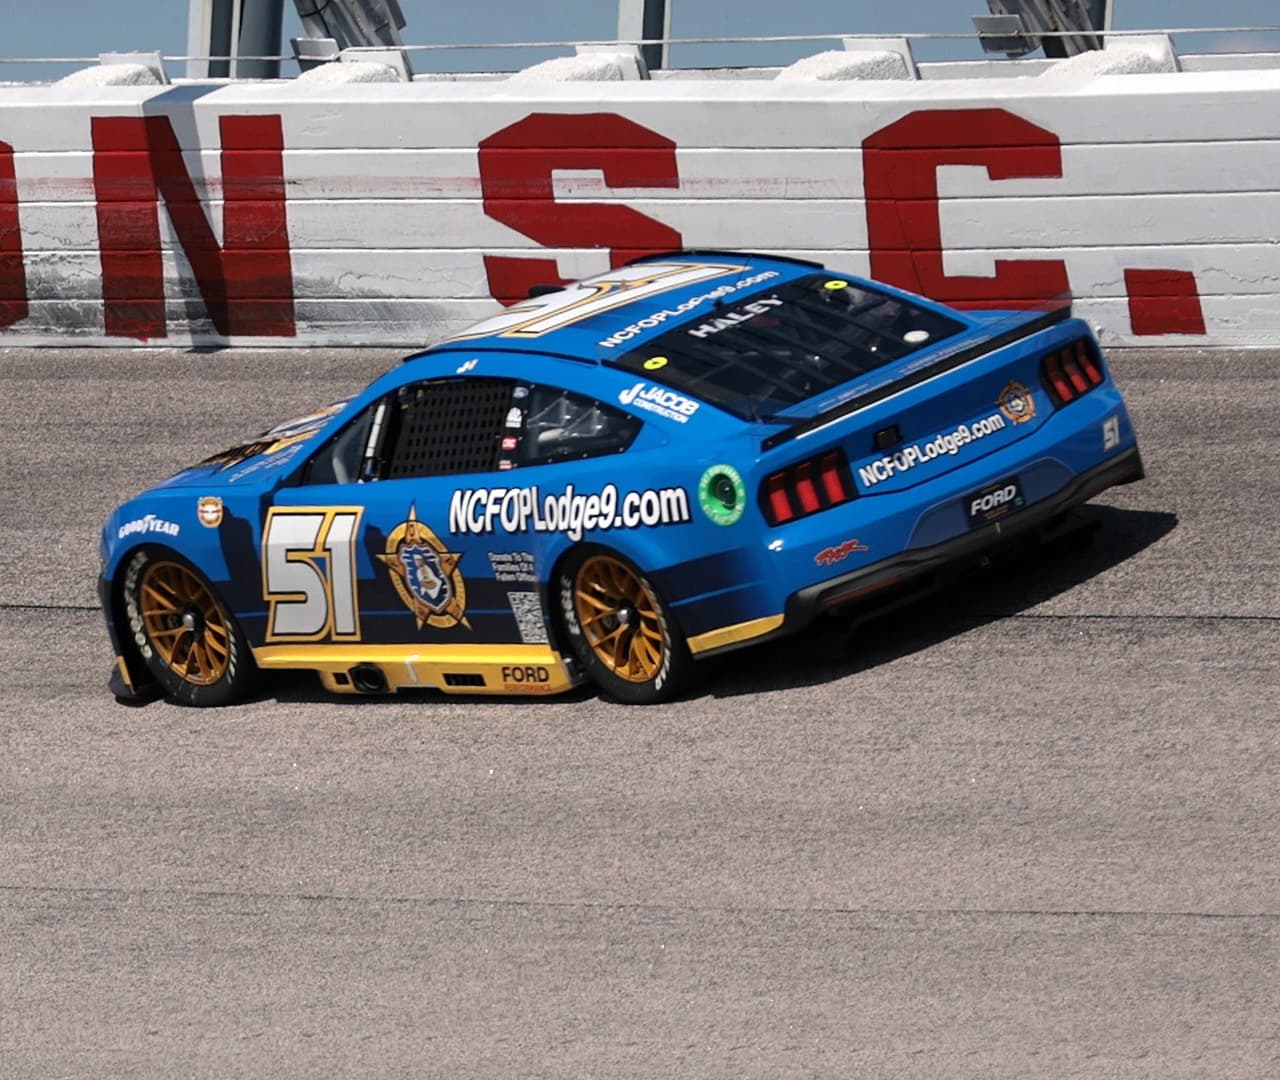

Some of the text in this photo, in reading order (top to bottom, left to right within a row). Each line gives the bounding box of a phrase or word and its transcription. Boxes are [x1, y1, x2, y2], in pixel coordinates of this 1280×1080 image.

[688, 294, 785, 339] HALEY
[638, 386, 700, 416] JACOB
[858, 413, 1006, 487] NCFOPLodge9.com
[1102, 415, 1120, 450] 51
[448, 484, 690, 541] NCFOPLodge9.com
[971, 484, 1017, 516] FORD
[118, 514, 180, 538] GOODYEAR
[263, 506, 365, 642] 51
[502, 666, 549, 682] FORD
